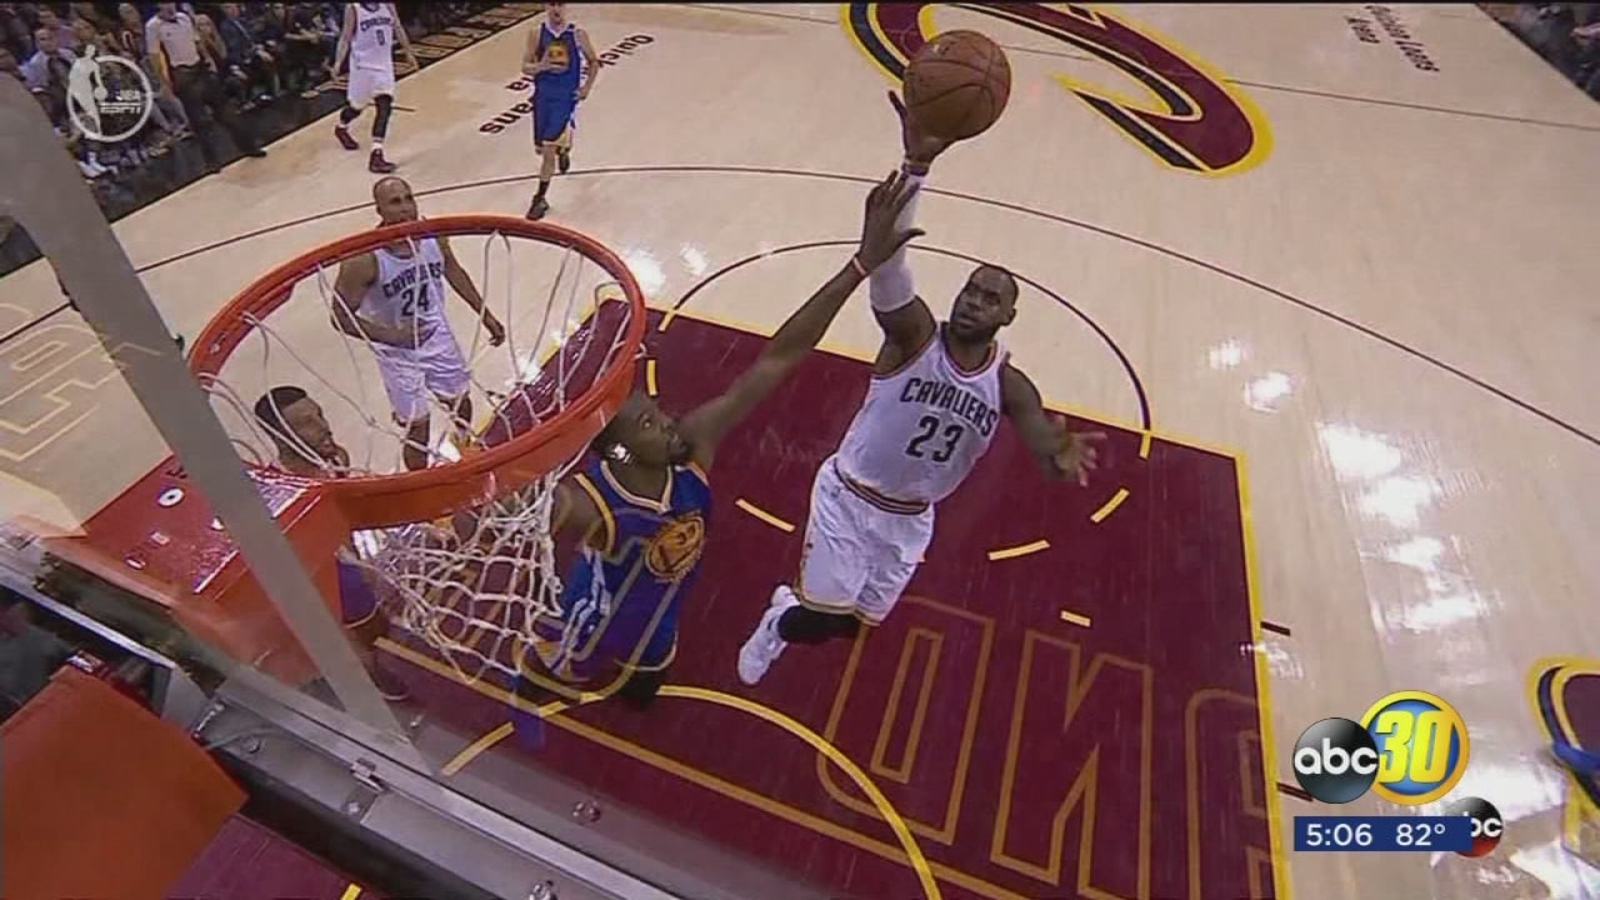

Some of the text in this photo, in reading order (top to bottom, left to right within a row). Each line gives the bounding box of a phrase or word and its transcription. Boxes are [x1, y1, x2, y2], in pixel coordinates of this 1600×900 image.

[401, 283, 429, 316] 24
[899, 377, 998, 437] CAVALIERS
[905, 415, 964, 463] 23
